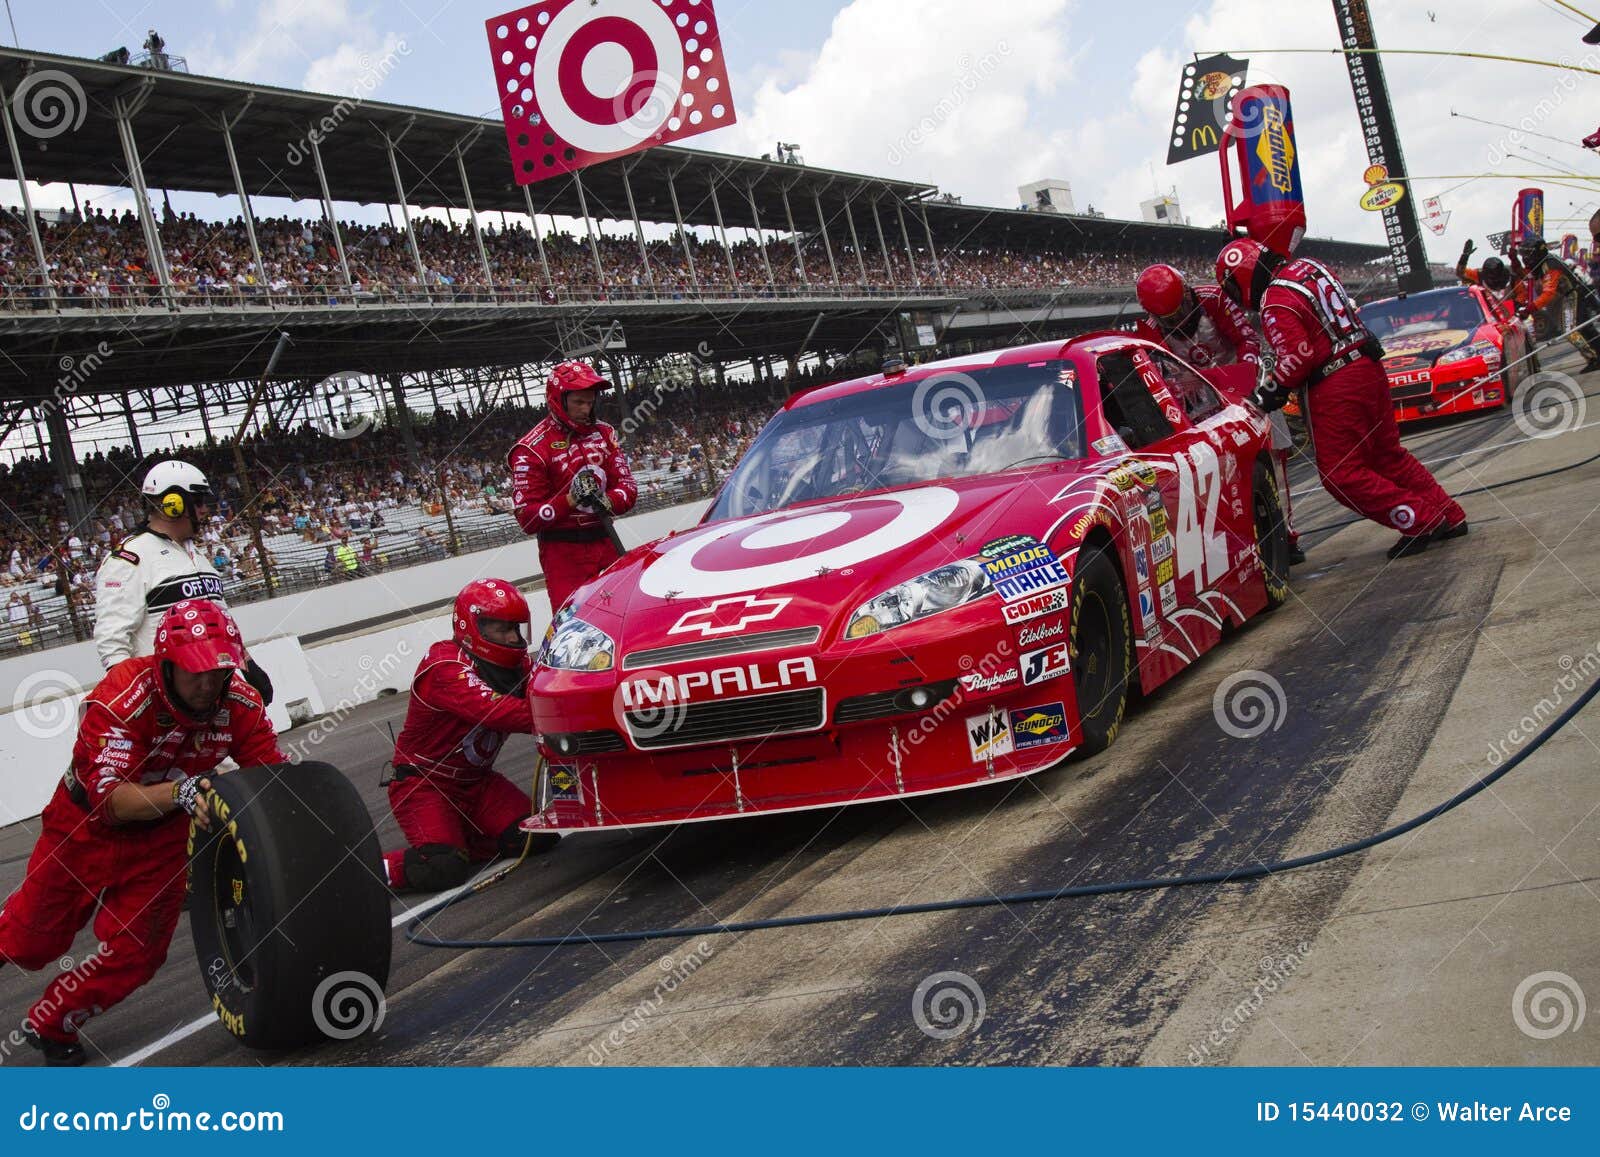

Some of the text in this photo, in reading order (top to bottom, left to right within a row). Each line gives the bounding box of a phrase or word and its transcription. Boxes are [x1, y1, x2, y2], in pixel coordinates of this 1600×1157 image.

[1343, 7, 1350, 16] 7
[1345, 16, 1353, 26] 8
[1347, 26, 1355, 36] 9
[1344, 37, 1358, 46] 10
[1349, 56, 1362, 67] 12
[1351, 66, 1365, 77] 13
[1354, 76, 1367, 87] 14
[1356, 86, 1369, 97] 15
[1358, 96, 1372, 107] 16
[1360, 106, 1374, 117] 17
[1363, 115, 1376, 126] 18
[1365, 125, 1379, 136] 19
[1366, 136, 1381, 146] 20
[1263, 105, 1292, 193] SUNOCO
[1369, 145, 1384, 156] 21
[1371, 155, 1386, 165] 22
[1366, 186, 1398, 207] PENNZOIL
[1383, 205, 1397, 216] 27
[1386, 215, 1400, 226] 28
[1388, 225, 1402, 236] 29
[1390, 235, 1404, 246] 30
[1392, 245, 1407, 256] 31
[1394, 255, 1409, 266] 32
[1397, 265, 1412, 275] 33
[1388, 371, 1430, 385] PALA
[1173, 440, 1230, 596] 42
[986, 546, 1050, 575] MOOG
[999, 562, 1069, 599] MAHLE
[1006, 594, 1053, 620] COMP
[1019, 619, 1064, 646] Edelbrock
[1025, 645, 1066, 684] JE
[620, 656, 817, 708] IMPALA
[965, 668, 1018, 691] Raybestos
[1014, 714, 1063, 733] SUNOCO
[207, 732, 233, 743] TUMS
[107, 738, 133, 751] NASCAR
[975, 736, 1010, 760] FILERS
[102, 756, 129, 769] PHOTO
